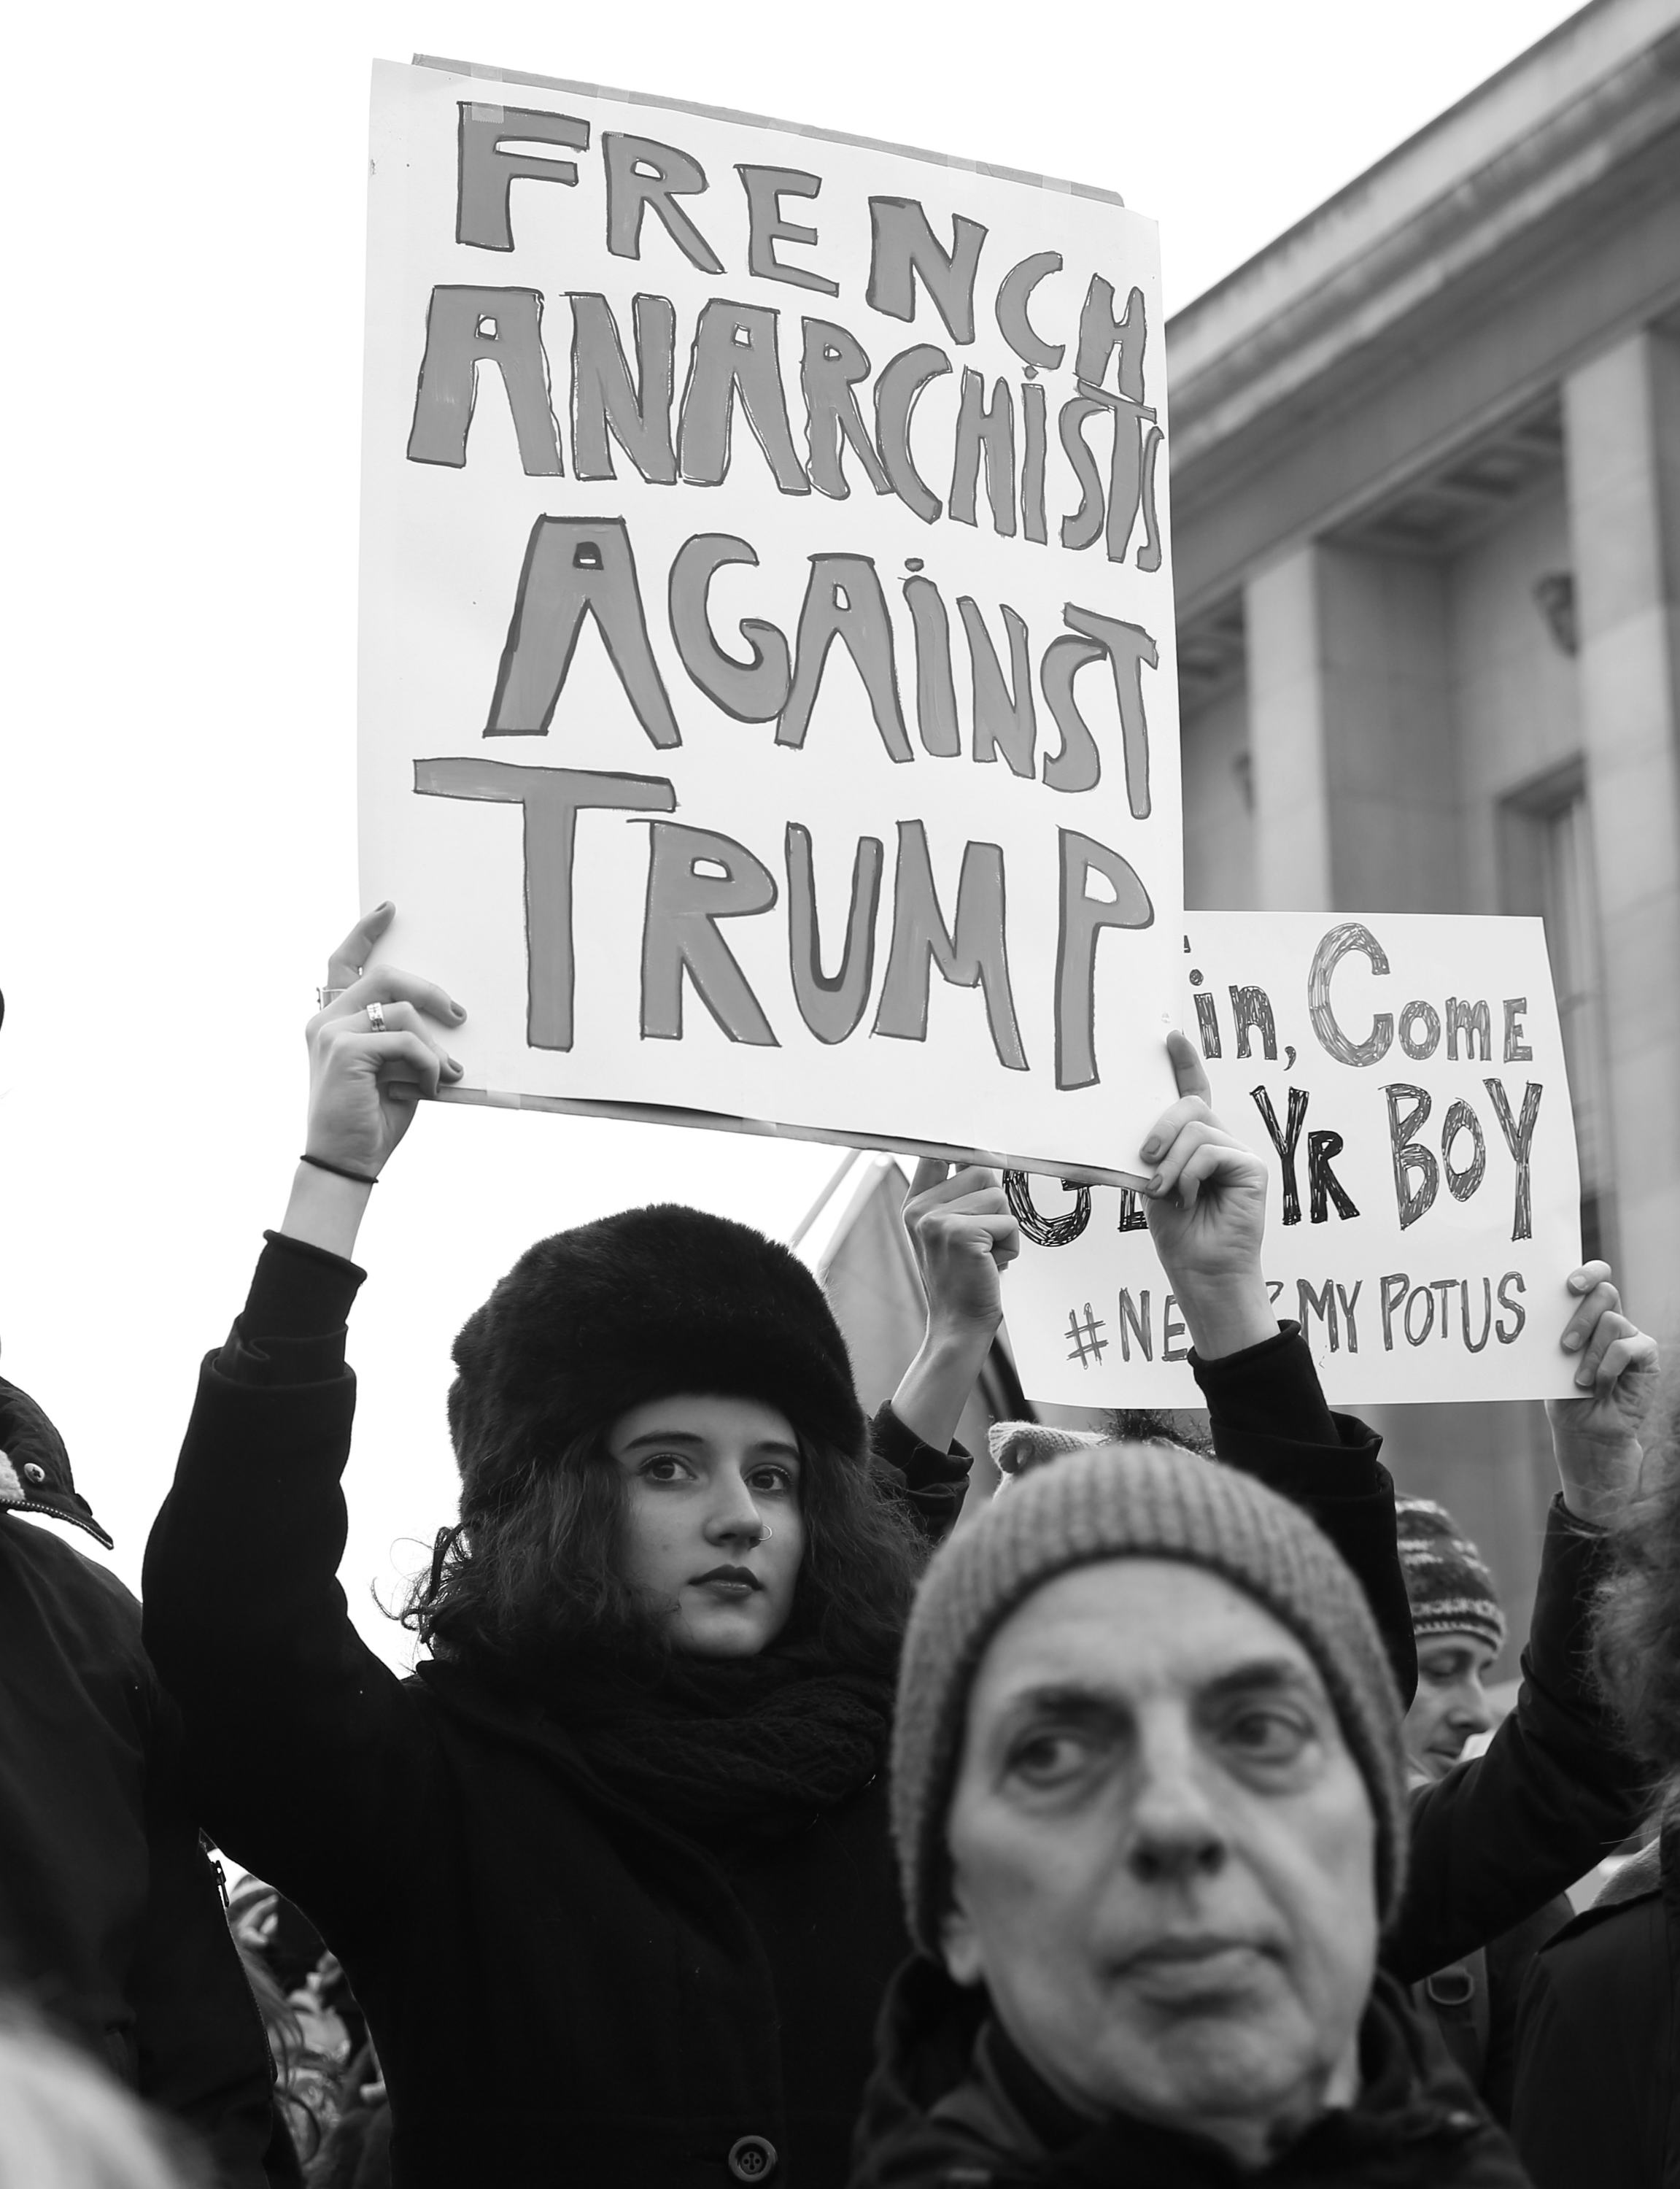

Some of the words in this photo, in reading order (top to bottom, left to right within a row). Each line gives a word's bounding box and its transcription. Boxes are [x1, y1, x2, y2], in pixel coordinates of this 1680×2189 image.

[456, 101, 1146, 402] FRENCH
[413, 757, 1155, 1090] TRUMP
[1183, 935, 1296, 1071] in,
[1378, 1078, 1544, 1242] BOY
[1296, 1278, 1363, 1354] MY
[1380, 1271, 1527, 1354] POTUS
